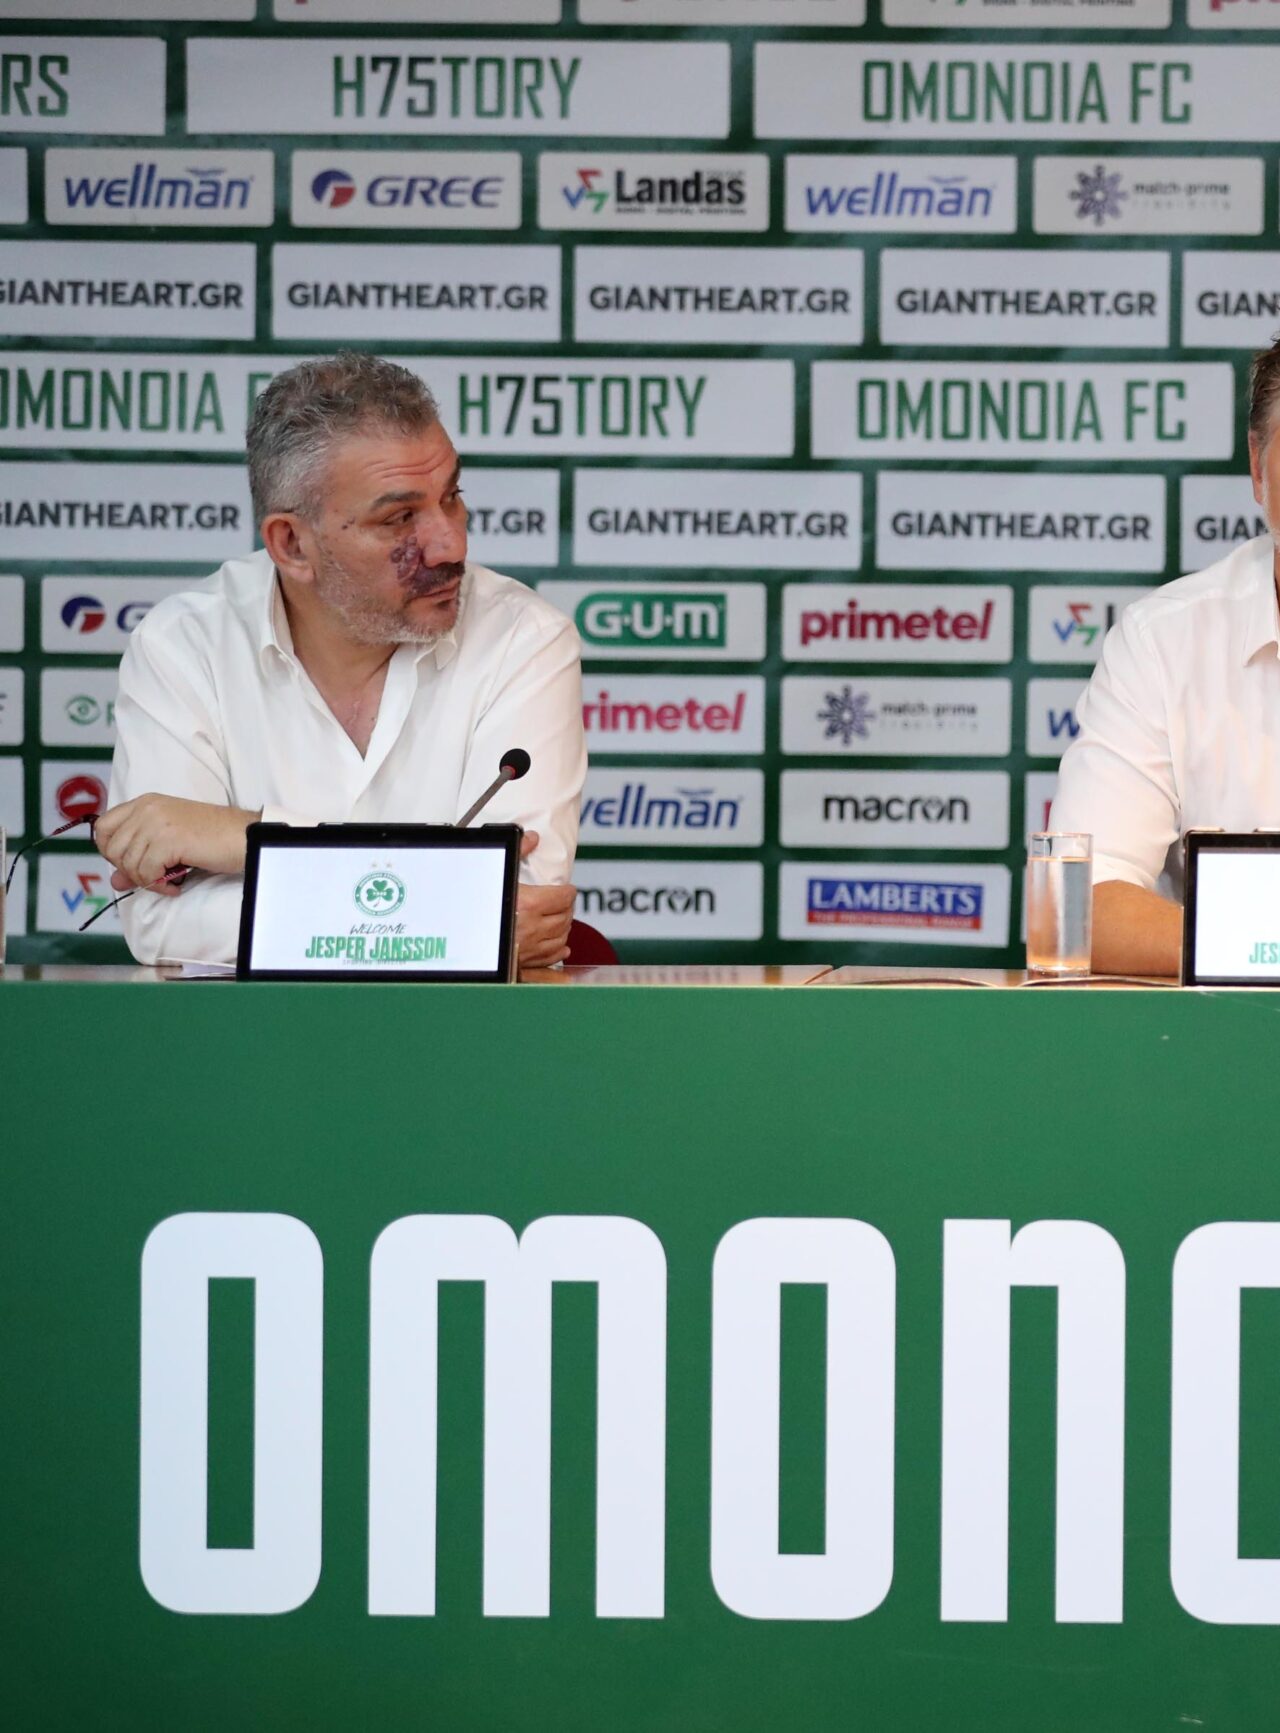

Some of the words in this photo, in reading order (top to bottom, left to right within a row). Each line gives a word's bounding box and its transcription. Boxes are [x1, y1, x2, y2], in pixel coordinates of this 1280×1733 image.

[333, 55, 580, 118] H75TORY
[862, 60, 1108, 123] OMONOIA
[1130, 62, 1192, 124] FC
[366, 176, 501, 207] GREE
[613, 166, 748, 205] Landas
[287, 282, 547, 310] GIANTHEART.GR
[589, 286, 849, 313] GIANTHEART.GR
[896, 288, 1156, 316] GIANTHEART.GR
[459, 374, 706, 437] H75TORY
[857, 379, 1101, 441] OMONOIA
[1125, 380, 1186, 441] FC
[588, 508, 847, 537] GIANTHEART.GR
[891, 511, 1150, 540] GIANTHEART.GR
[800, 599, 993, 646] primetel
[823, 796, 968, 821] macron
[812, 881, 977, 915] LAMBERTS
[305, 936, 366, 959] JESPER
[369, 936, 447, 961] JANSSON
